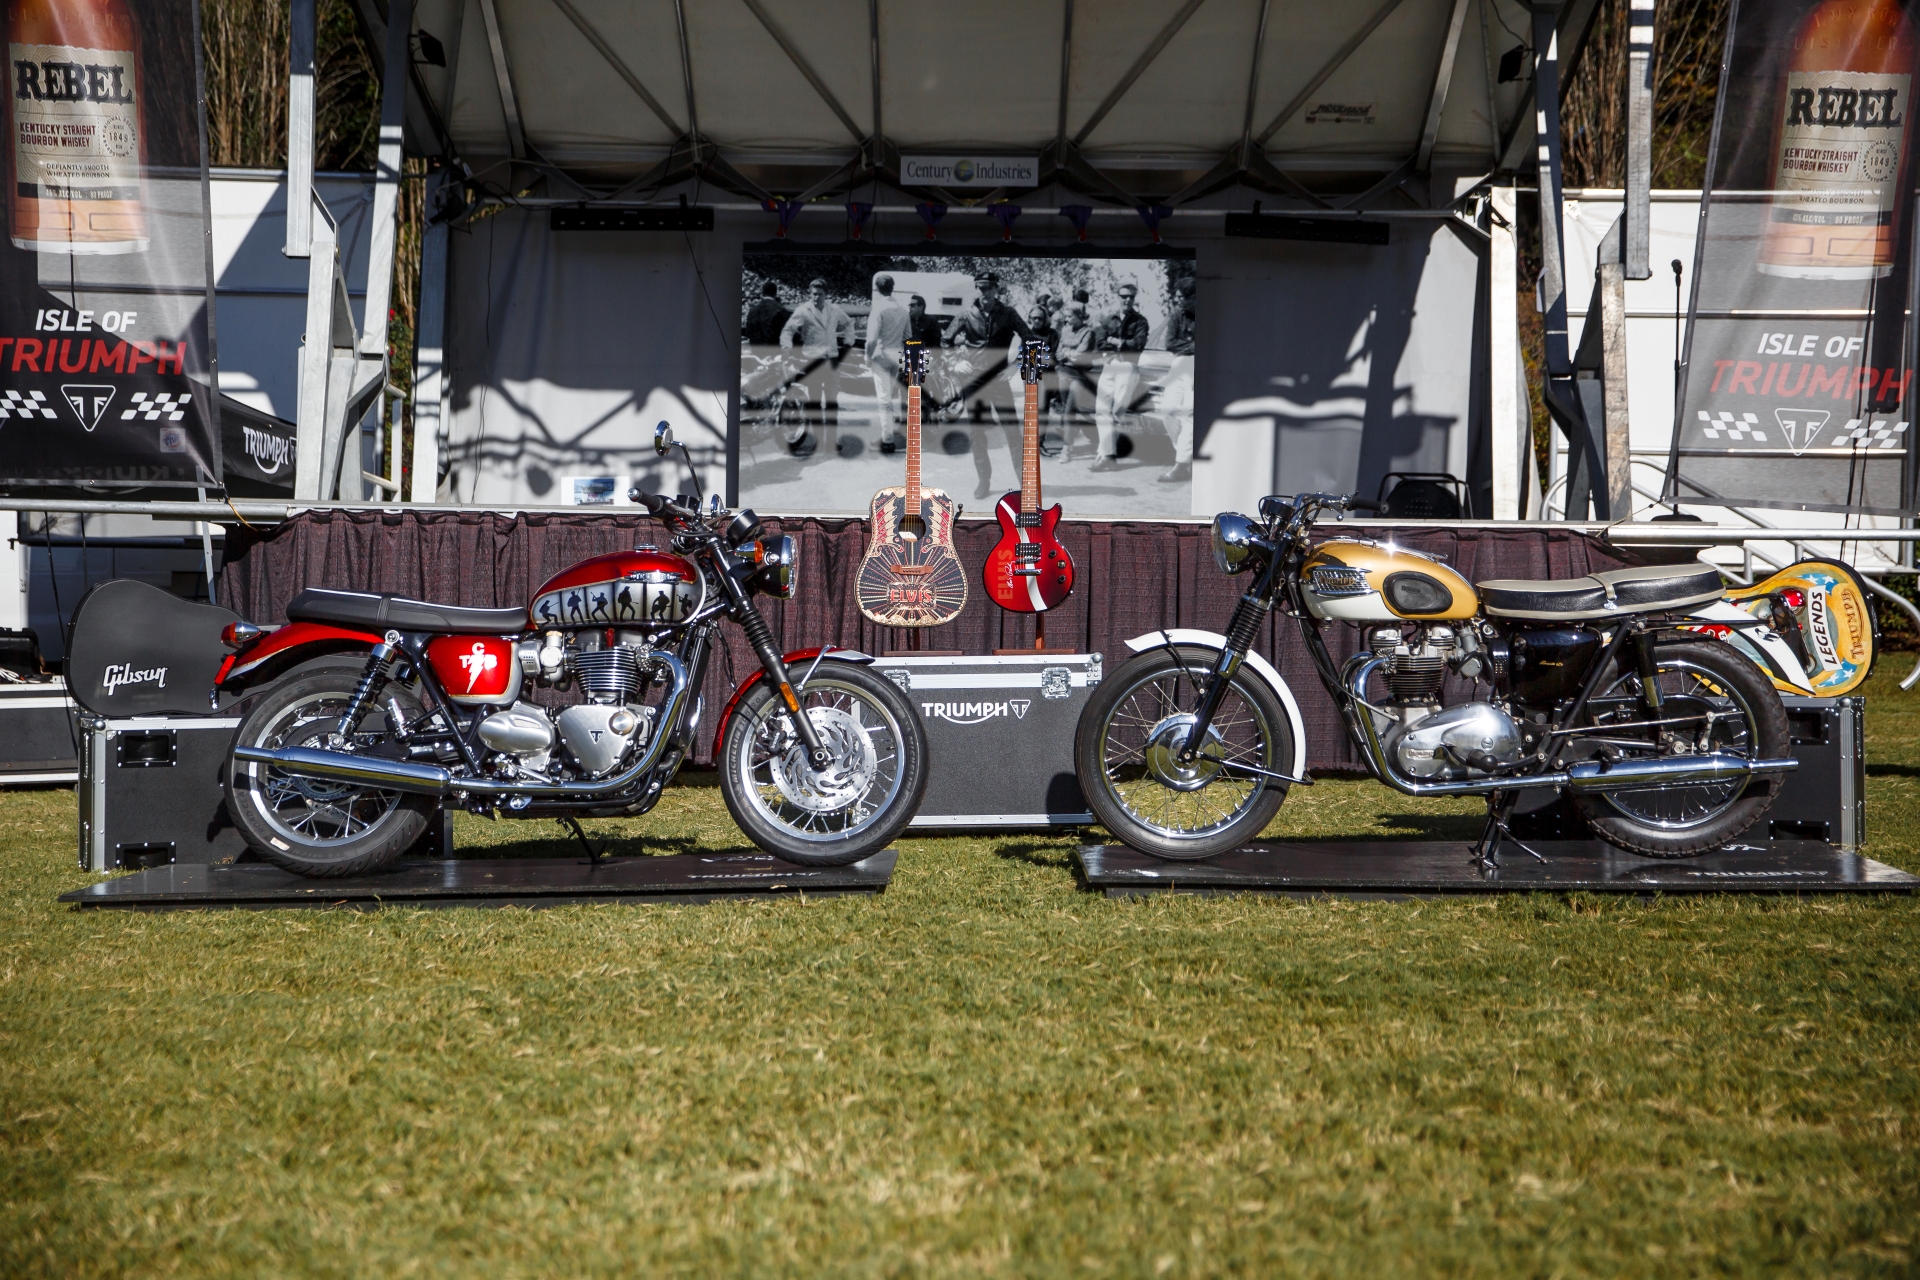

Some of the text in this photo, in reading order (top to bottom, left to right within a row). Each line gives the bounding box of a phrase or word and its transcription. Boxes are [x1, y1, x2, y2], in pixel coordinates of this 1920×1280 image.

[14, 58, 134, 105] REBEL
[1787, 86, 1903, 129] REBEL
[19, 121, 96, 136] KENTUCKY STRAIGHT
[20, 133, 90, 148] BOURBON WHISKEY
[109, 132, 128, 143] 1849
[46, 163, 83, 171] DEFIANTLY
[1782, 159, 1850, 174] BOURBON WHISKEY
[1784, 147, 1859, 162] KENTUCKY STRAIGHT
[1870, 156, 1890, 168] 1849
[907, 161, 1032, 182] Century Industries
[35, 308, 138, 333] ISLE OF
[0, 337, 187, 375] TRIUMPH
[1757, 332, 1865, 359] ISLE OF
[1709, 359, 1914, 403] TRIUMPH
[242, 425, 289, 470] TRIUMPH
[997, 549, 1014, 600] ELVIS
[890, 588, 932, 603] ELVIS
[1811, 591, 1838, 667] LEGENDS
[1841, 587, 1865, 660] TRIUMPH
[103, 662, 168, 696] Gibson
[921, 702, 1008, 723] TRIUMPH
[730, 730, 741, 783] MICHELIN
[907, 735, 917, 790] MICHELIN
